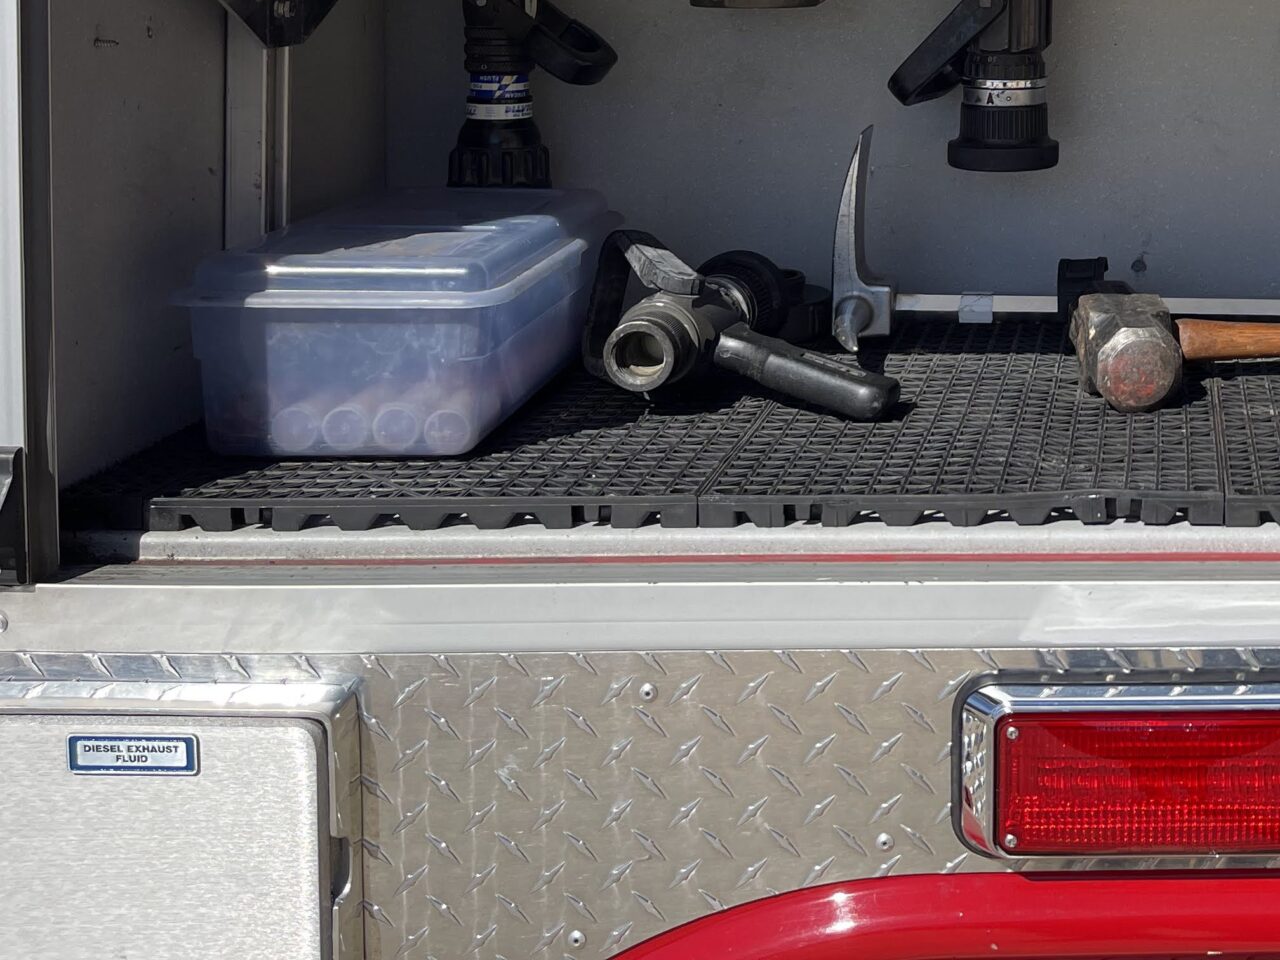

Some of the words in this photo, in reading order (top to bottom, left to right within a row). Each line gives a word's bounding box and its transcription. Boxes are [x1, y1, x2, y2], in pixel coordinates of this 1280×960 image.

[83, 744, 124, 753] DIESEL
[127, 744, 180, 754] EXHAUST
[115, 754, 148, 763] FLUID
